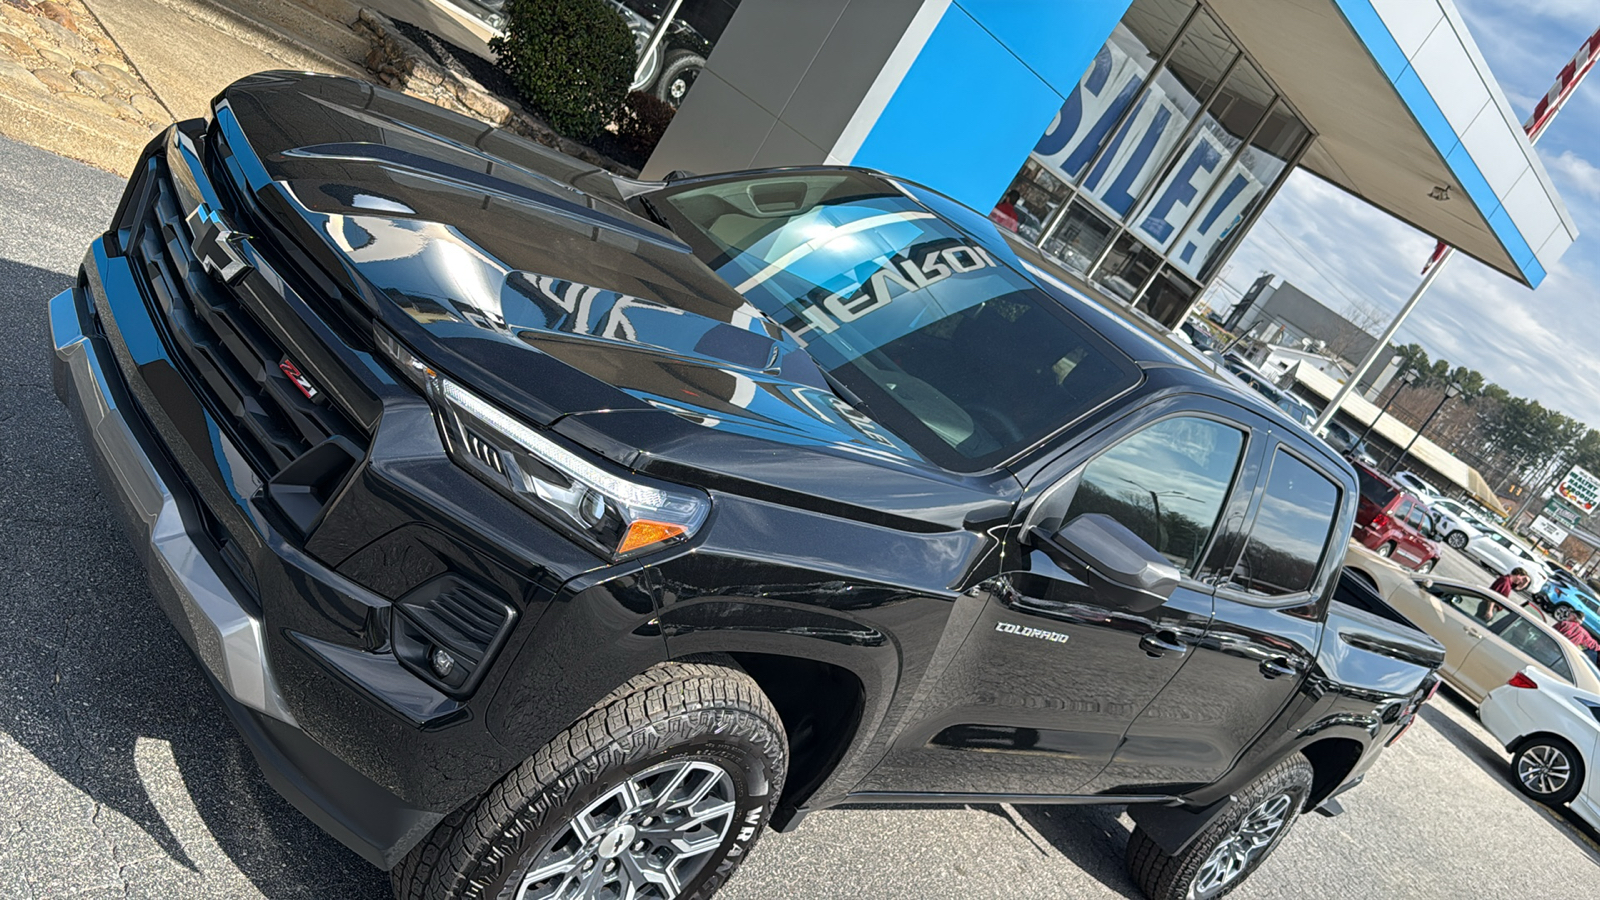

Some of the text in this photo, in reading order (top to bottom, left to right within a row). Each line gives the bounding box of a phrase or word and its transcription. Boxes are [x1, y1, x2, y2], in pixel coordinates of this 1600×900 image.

[1033, 43, 1248, 264] SALE!
[279, 359, 318, 398] Z71
[1568, 478, 1598, 499] HARVEST
[1569, 471, 1598, 491] HEALTHY
[1566, 484, 1597, 507] PRODUCE
[996, 621, 1069, 643] COLORADO
